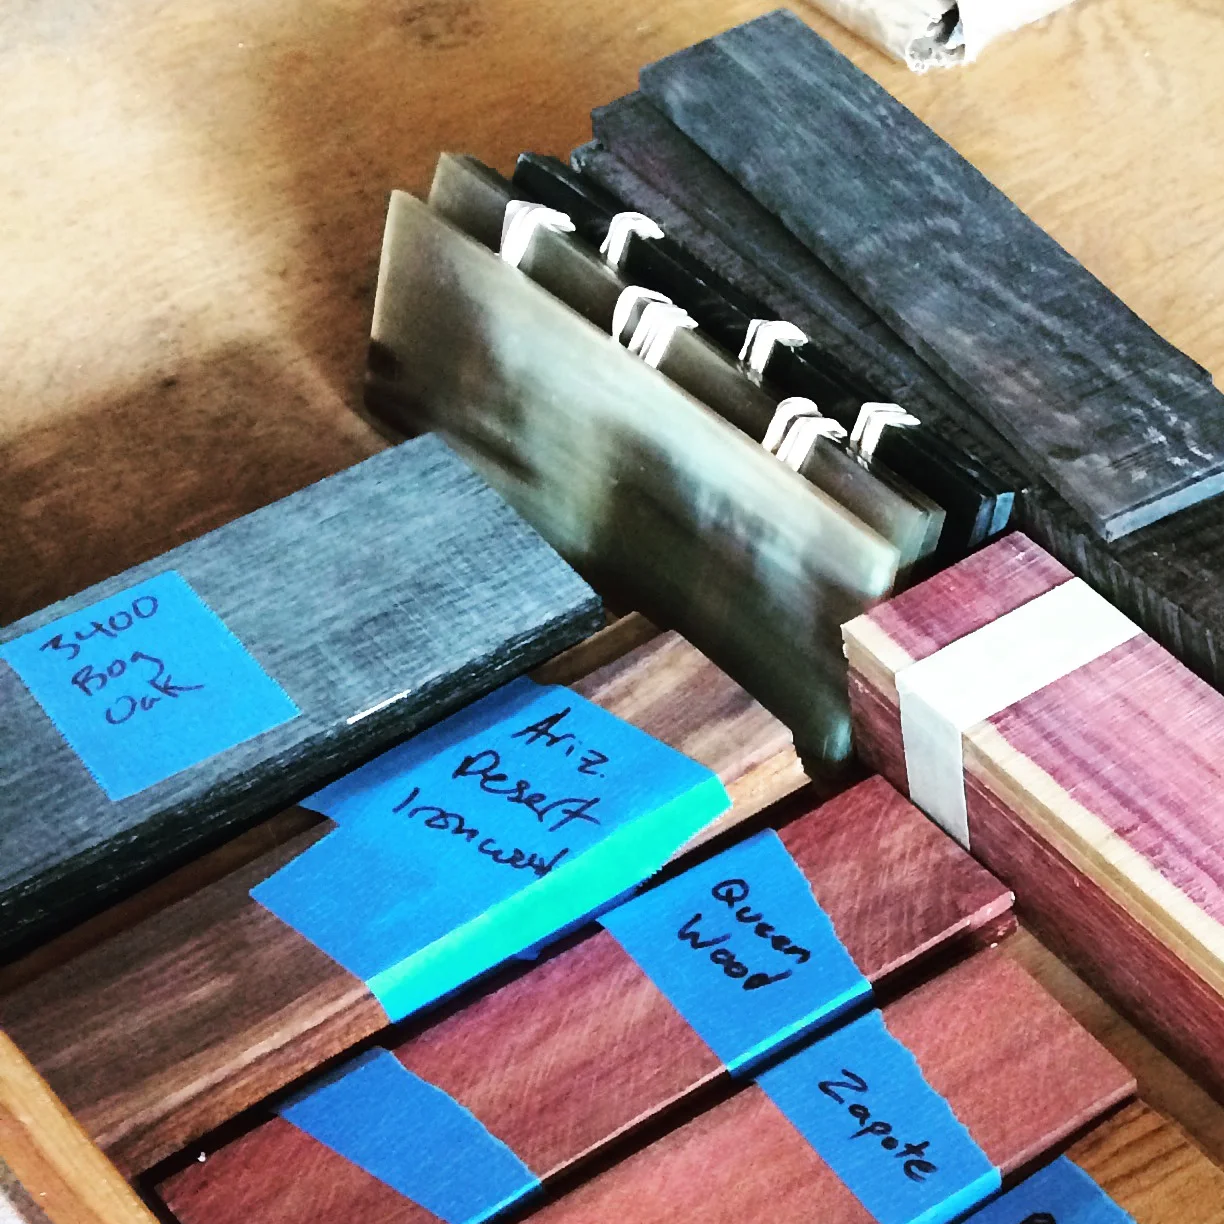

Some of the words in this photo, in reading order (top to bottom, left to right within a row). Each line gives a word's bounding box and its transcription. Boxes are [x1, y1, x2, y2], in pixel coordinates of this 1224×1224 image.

[452, 750, 601, 832] Desert
[711, 878, 811, 964] Queen
[818, 1068, 938, 1182] Zapote
